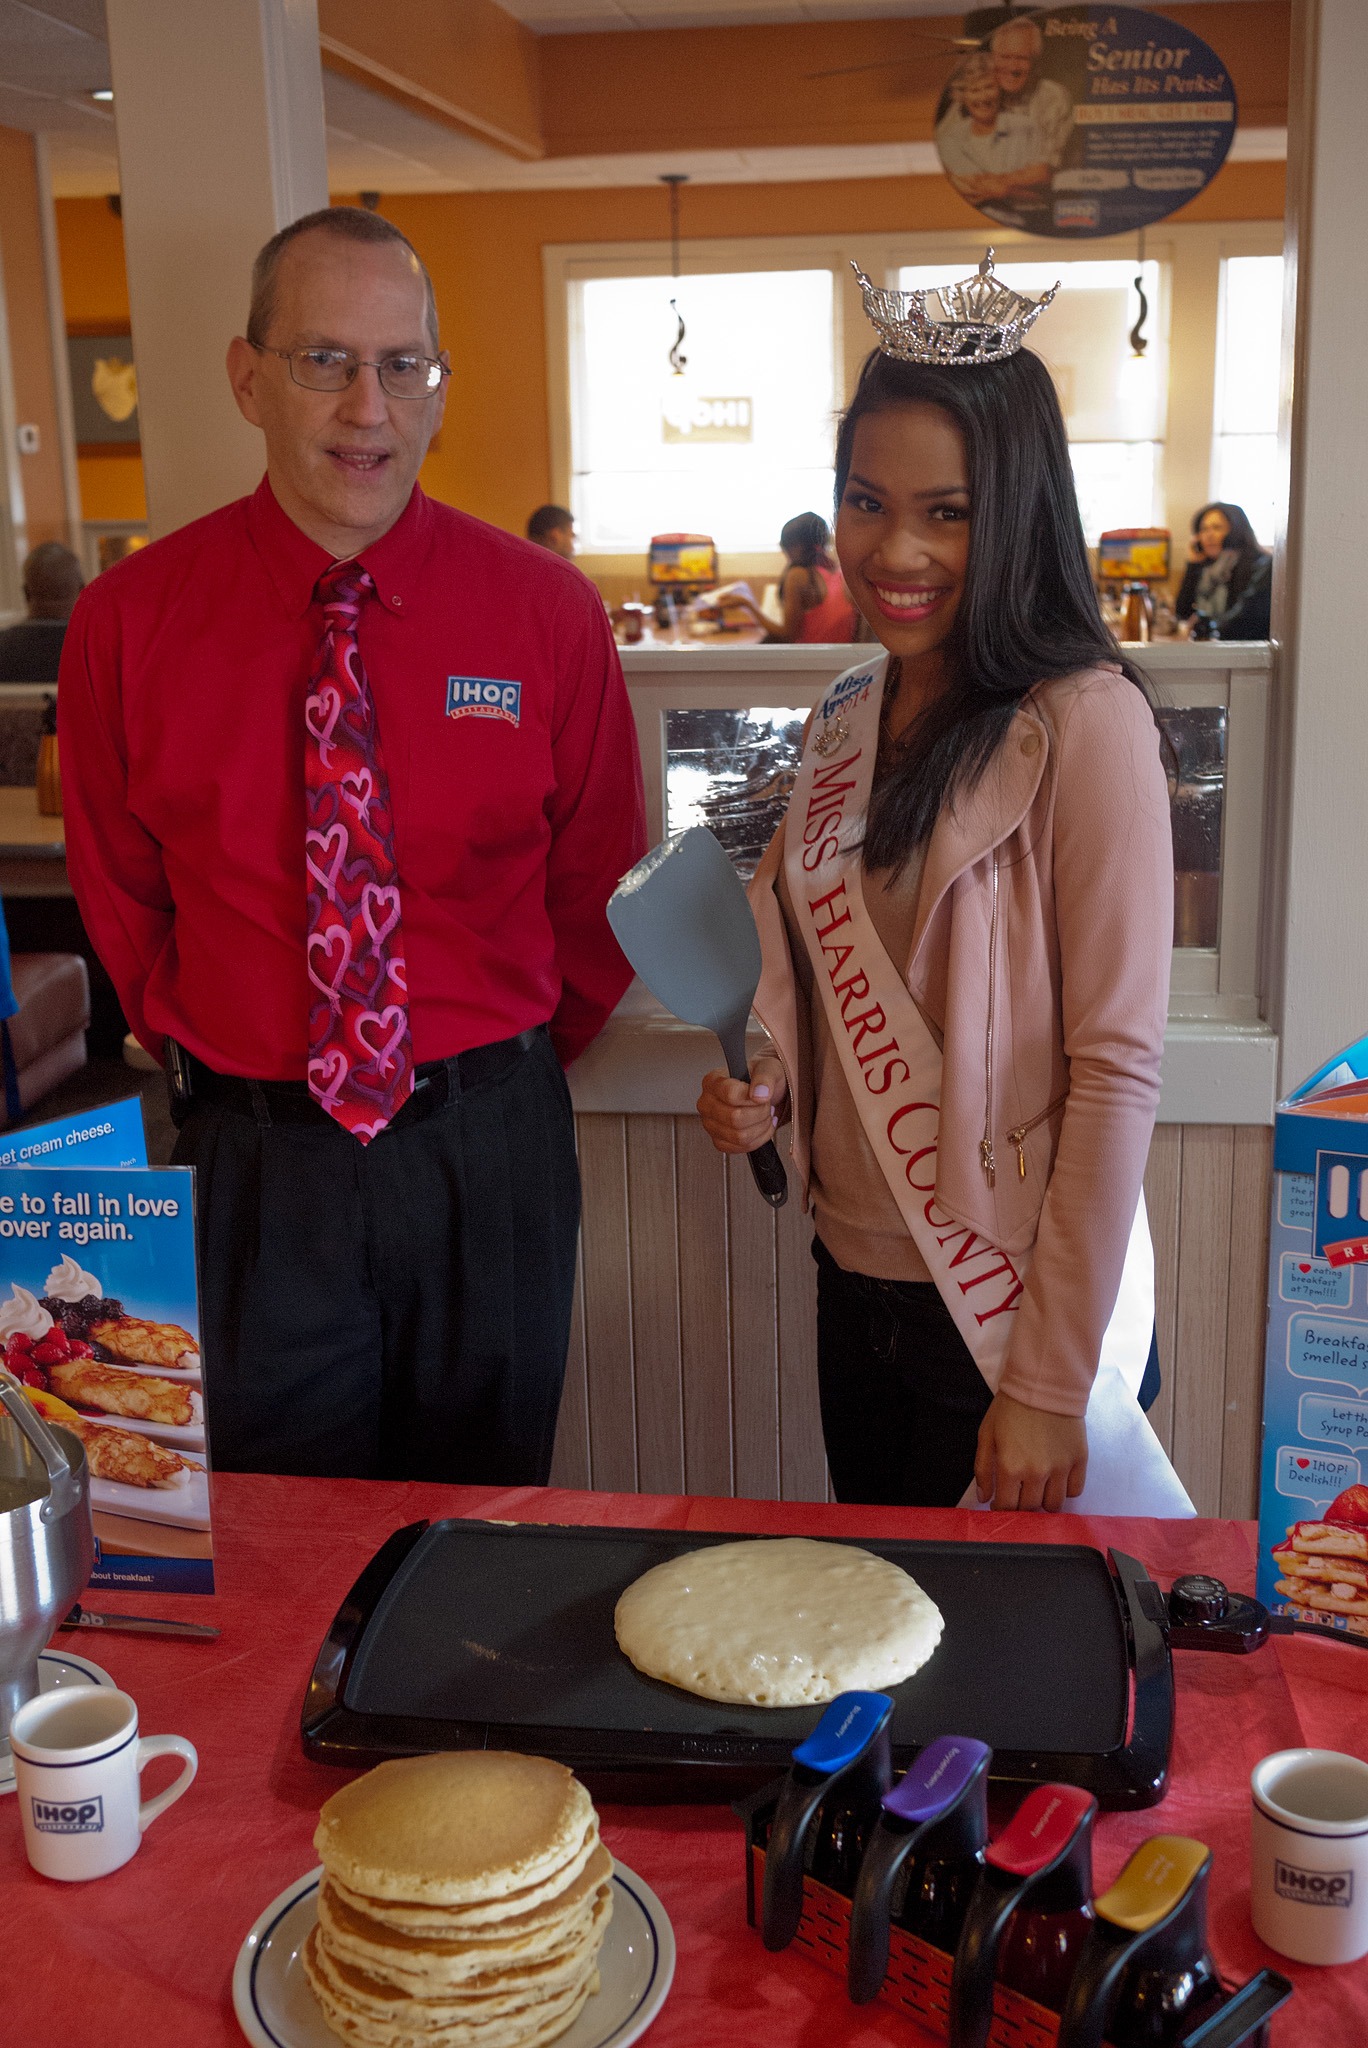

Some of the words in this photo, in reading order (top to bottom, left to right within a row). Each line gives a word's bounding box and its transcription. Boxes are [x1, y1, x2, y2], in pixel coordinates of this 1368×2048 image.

[1102, 16, 1118, 35] A
[1086, 41, 1191, 71] Senior
[1091, 75, 1129, 94] Has
[1133, 75, 1160, 94] Its
[452, 681, 517, 711] IHOP
[802, 748, 863, 862] MISS
[808, 877, 911, 1096] HARRIS
[0, 1148, 17, 1166] et
[20, 1137, 63, 1160] cream
[65, 1122, 115, 1147] cheese.
[20, 1192, 46, 1215] to
[52, 1191, 90, 1216] fall
[98, 1192, 121, 1217] in
[128, 1193, 179, 1217] love
[886, 1101, 1025, 1328] COUNTY
[0, 1219, 51, 1239] over
[58, 1217, 134, 1246] again.
[1291, 1262, 1296, 1271] I
[1313, 1268, 1343, 1279] eating
[1291, 1274, 1338, 1287] breakfast
[1332, 1408, 1353, 1421] Let
[1320, 1420, 1353, 1438] Syrup
[1288, 1456, 1294, 1466] I
[1312, 1459, 1348, 1476] IHOP!
[1288, 1469, 1342, 1488] Deelish!!!
[36, 1804, 97, 1825] IHOP
[1279, 1867, 1346, 1898] IHOP
